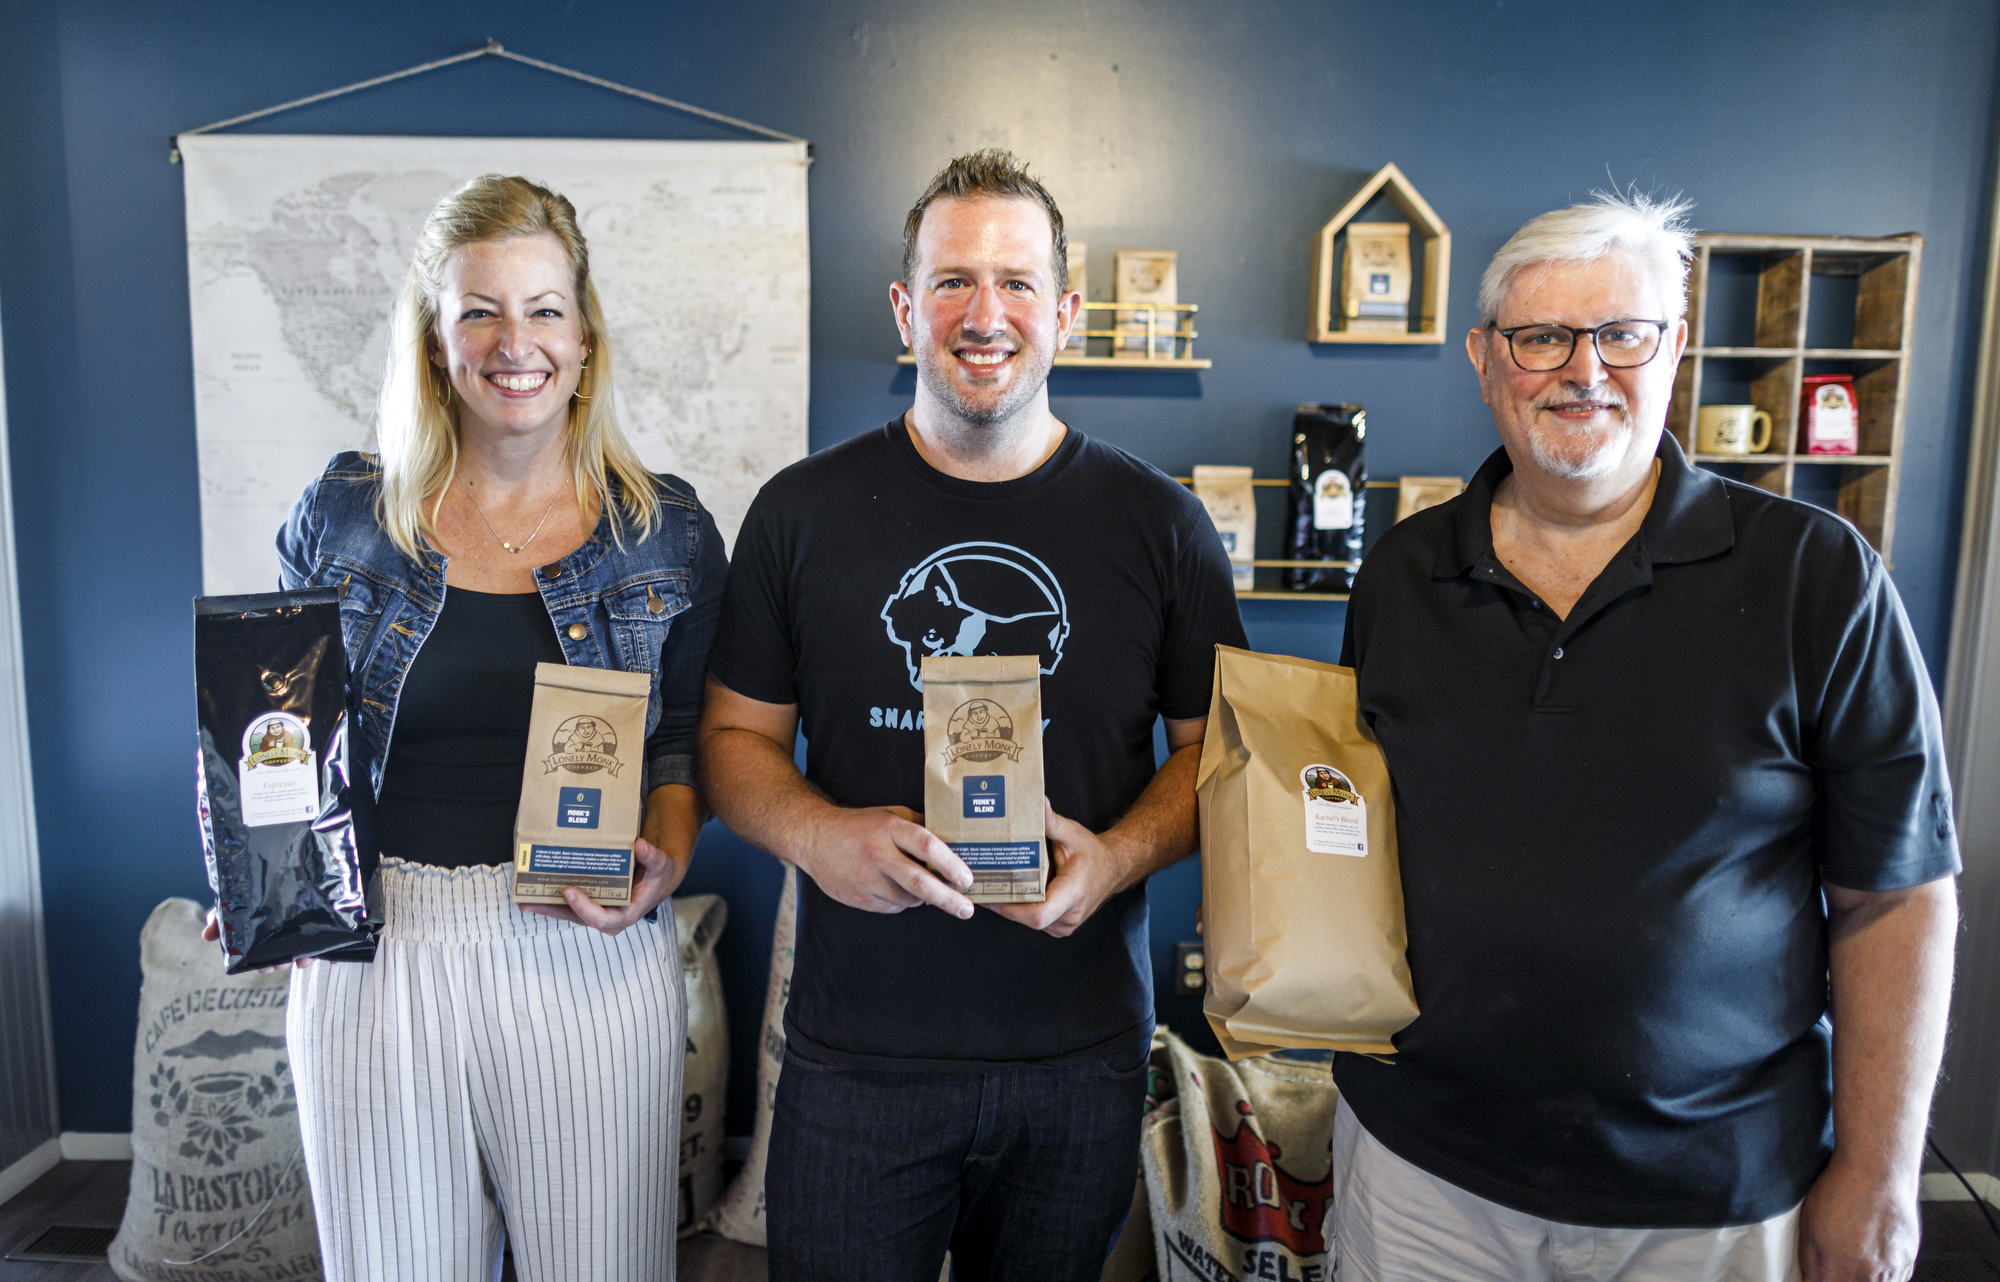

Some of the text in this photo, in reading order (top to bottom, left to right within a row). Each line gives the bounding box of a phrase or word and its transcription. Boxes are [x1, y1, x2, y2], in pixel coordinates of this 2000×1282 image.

[869, 706, 924, 731] SNAR
[251, 748, 305, 764] LONELY MONK
[950, 740, 1014, 756] LONELY MONK
[552, 753, 615, 768] LONELY MONK
[263, 780, 296, 790] Espresso
[972, 798, 996, 806] MONK'S
[567, 809, 590, 817] MONK'S
[567, 816, 588, 824] BLEND
[1315, 813, 1359, 824] Rachel's Blend
[145, 998, 185, 1053] CAFE
[153, 1167, 179, 1209] LA
[1224, 1160, 1334, 1233] ROY
[1243, 1249, 1323, 1282] SELE
